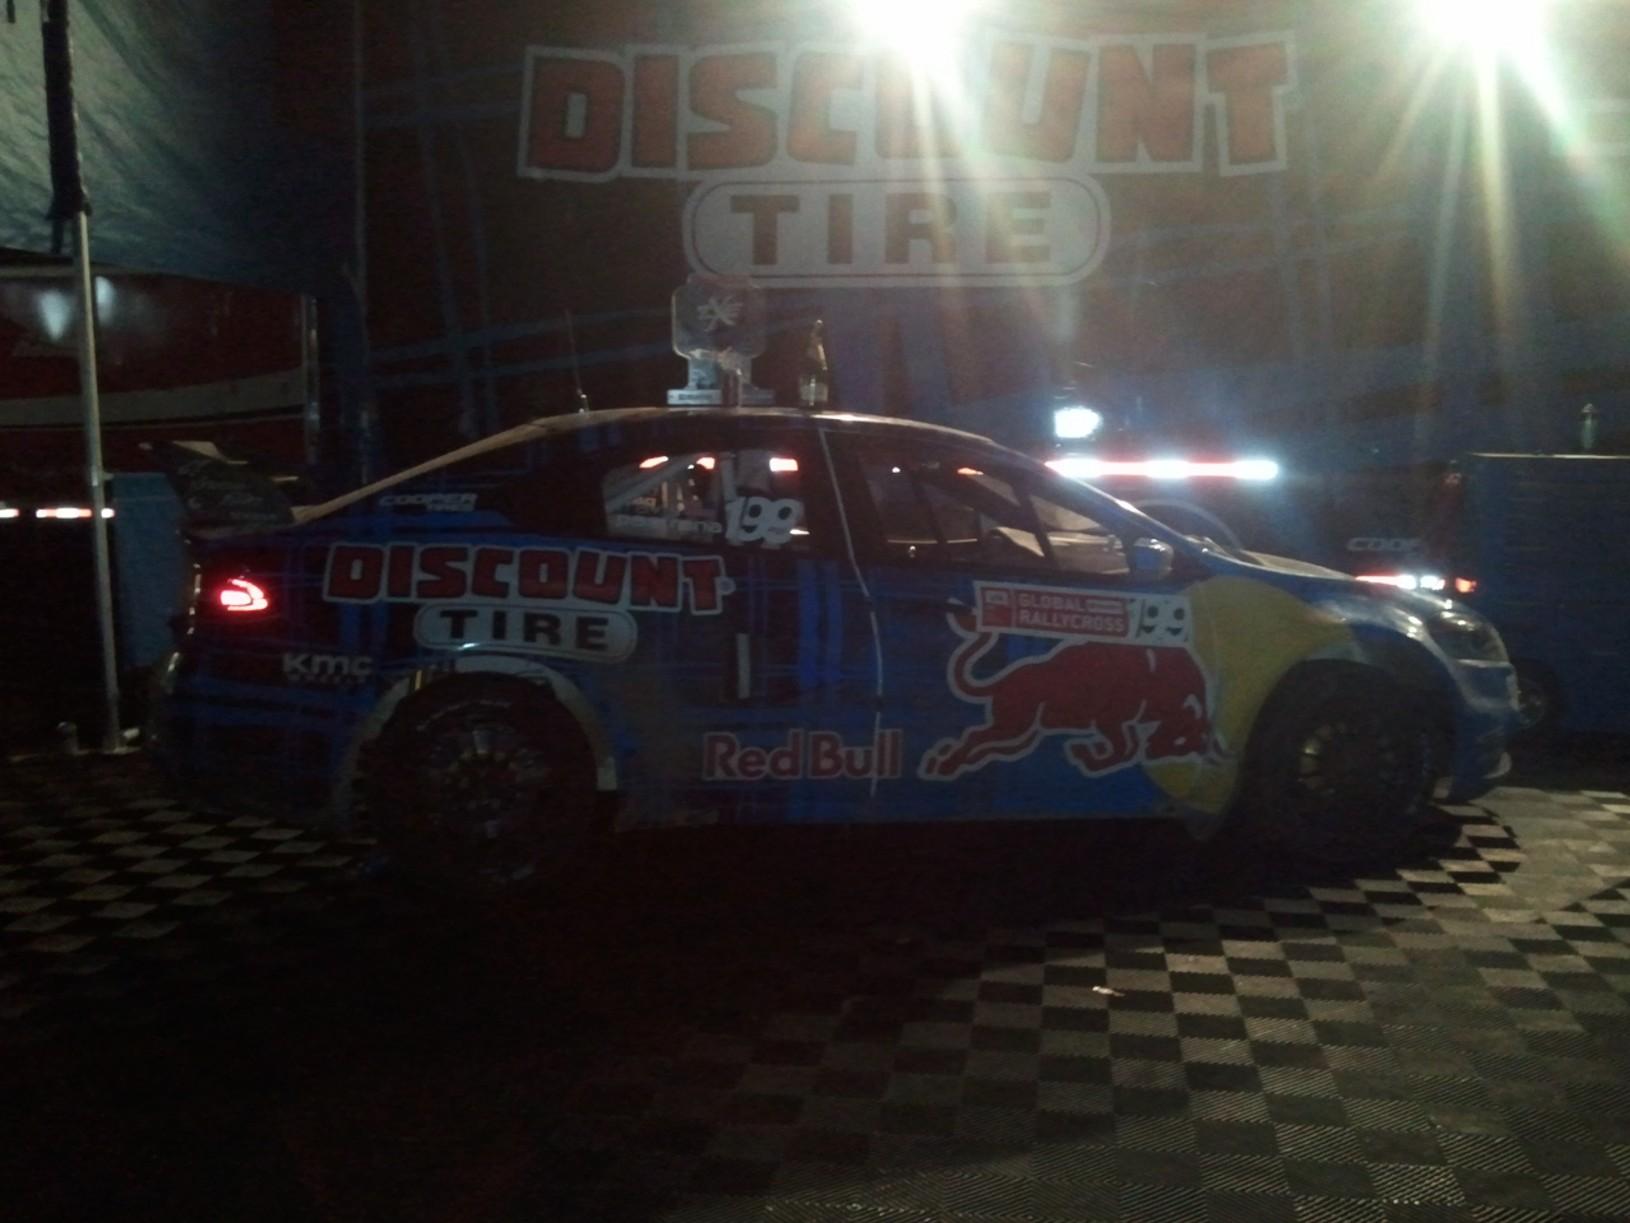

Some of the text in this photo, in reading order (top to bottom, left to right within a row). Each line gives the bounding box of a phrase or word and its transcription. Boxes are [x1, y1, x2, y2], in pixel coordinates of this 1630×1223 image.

[730, 189, 1053, 266] TIRE
[325, 544, 727, 614] DISCOUNT
[1018, 592, 1084, 612] GLOBAL
[439, 608, 609, 651] TIRE
[1018, 608, 1125, 633] RALLYCROSS
[703, 728, 903, 780] Red Bull
